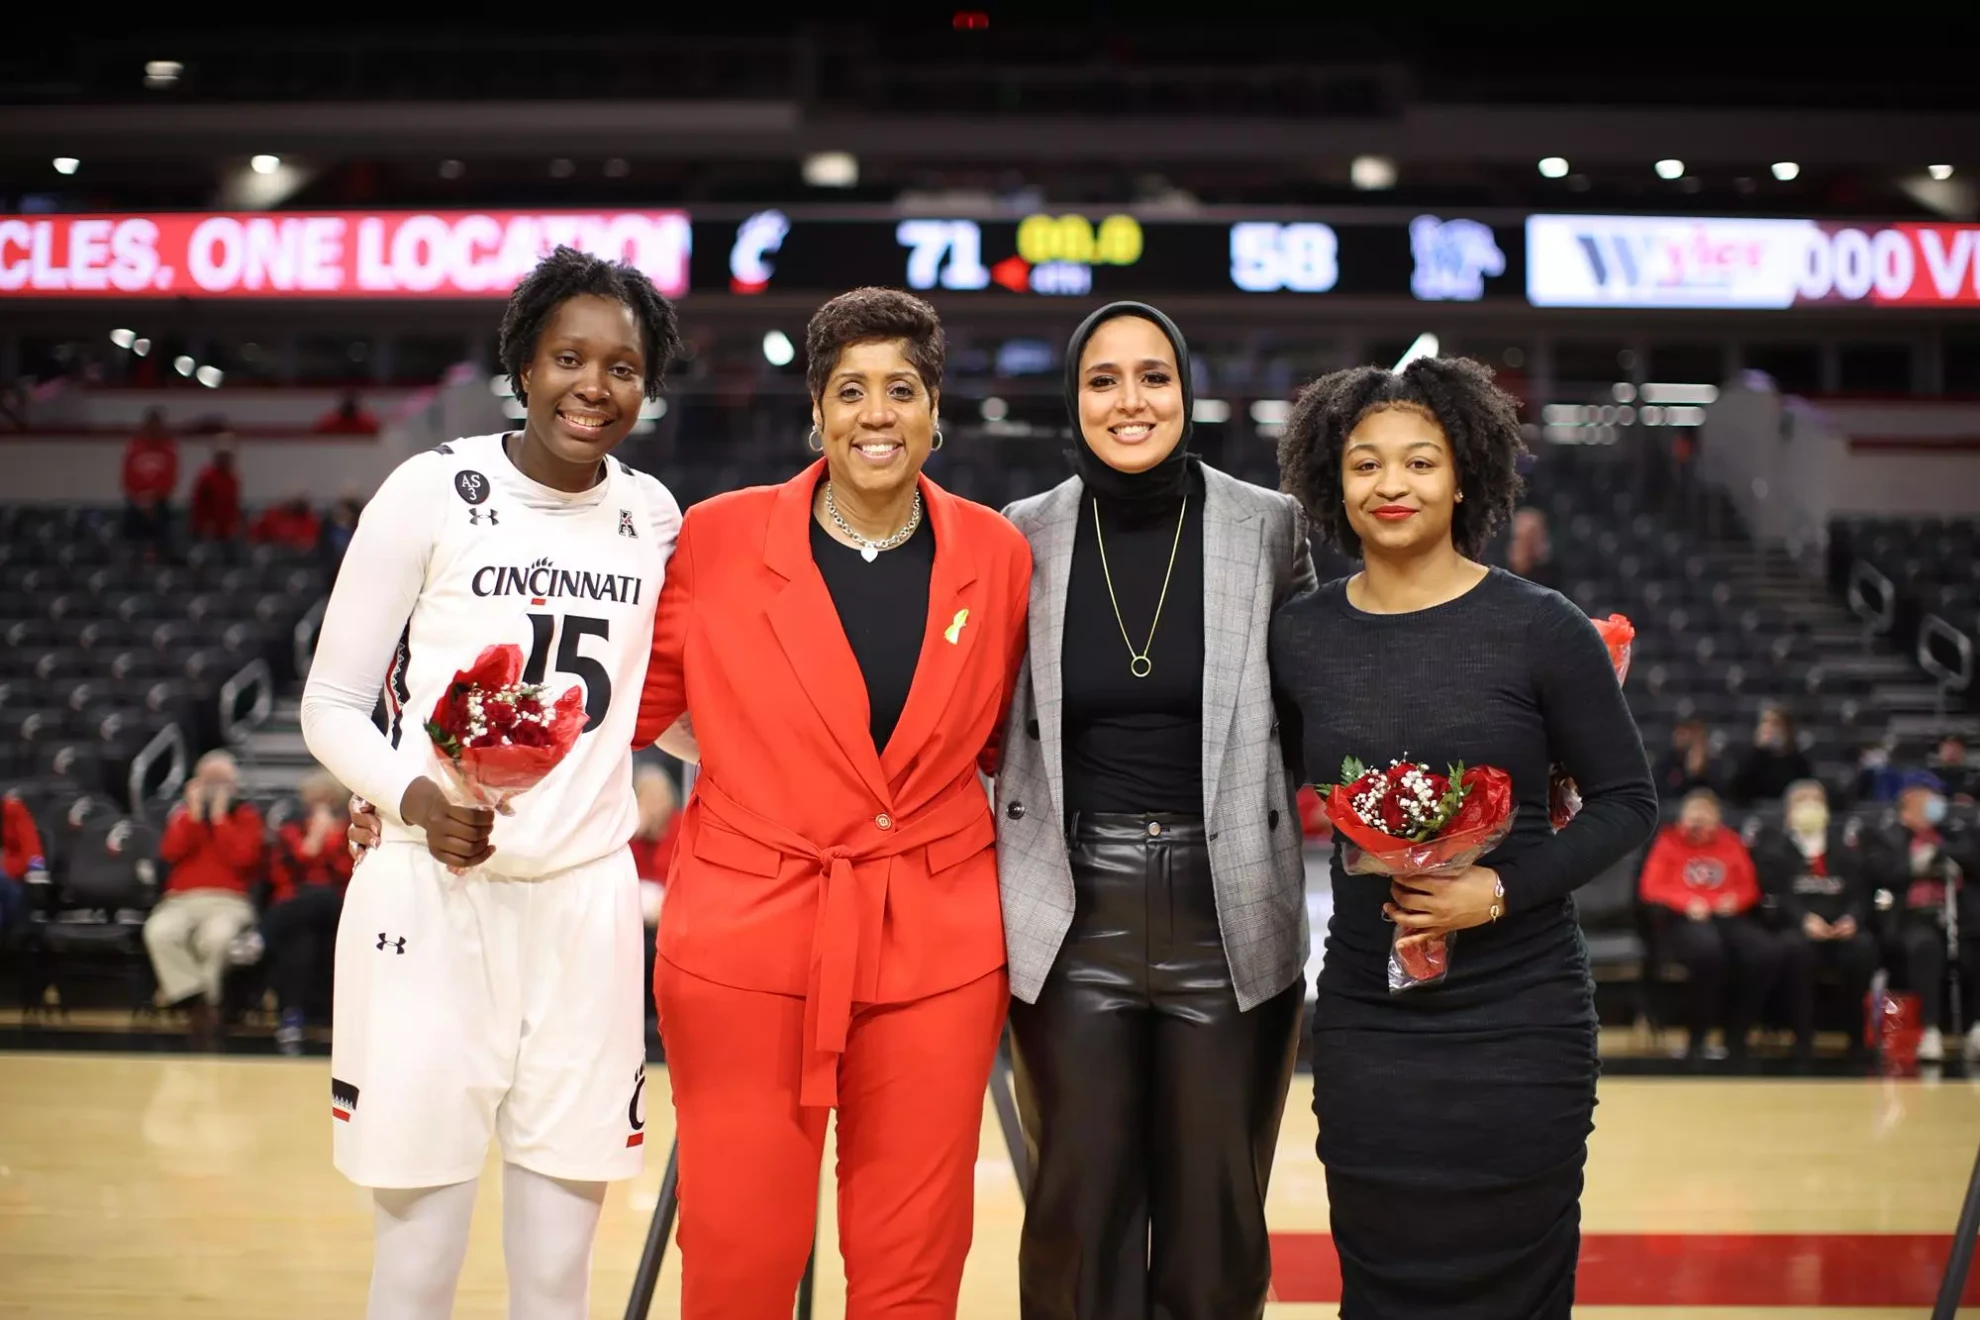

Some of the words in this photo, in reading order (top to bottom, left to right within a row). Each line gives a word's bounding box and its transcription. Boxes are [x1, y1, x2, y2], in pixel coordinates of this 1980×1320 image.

[188, 217, 346, 291] ONE
[896, 219, 990, 290] 71
[1229, 221, 1339, 293] 58
[462, 474, 481, 488] AS
[467, 487, 477, 501] 3
[471, 561, 642, 606] CINCINNATI
[522, 612, 612, 734] 15
